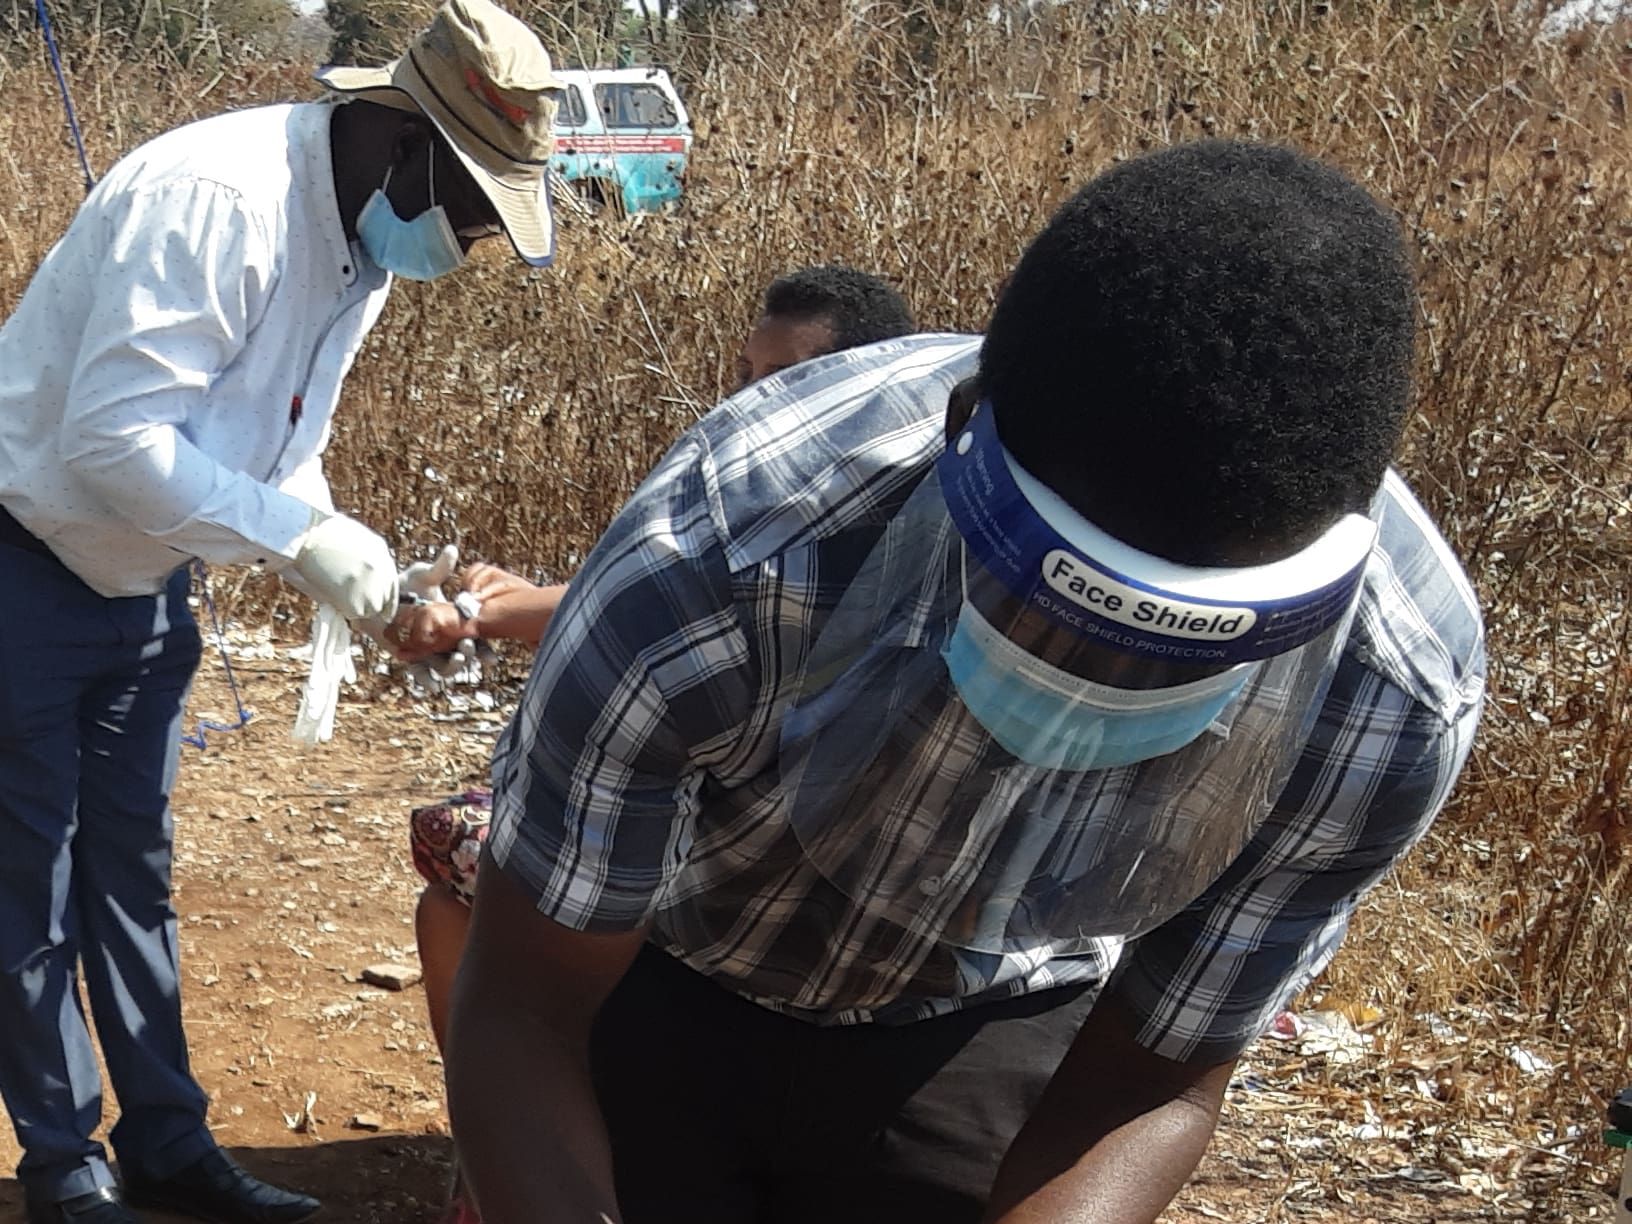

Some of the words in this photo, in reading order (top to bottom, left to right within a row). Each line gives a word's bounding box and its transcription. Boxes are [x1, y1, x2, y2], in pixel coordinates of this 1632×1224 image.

[1032, 589, 1051, 609] HD
[1052, 602, 1083, 630] FACE
[1085, 621, 1135, 650] SHIELD
[1135, 640, 1227, 660] PROTECTION
[1051, 556, 1122, 613] Face
[1133, 606, 1245, 637] Shield
